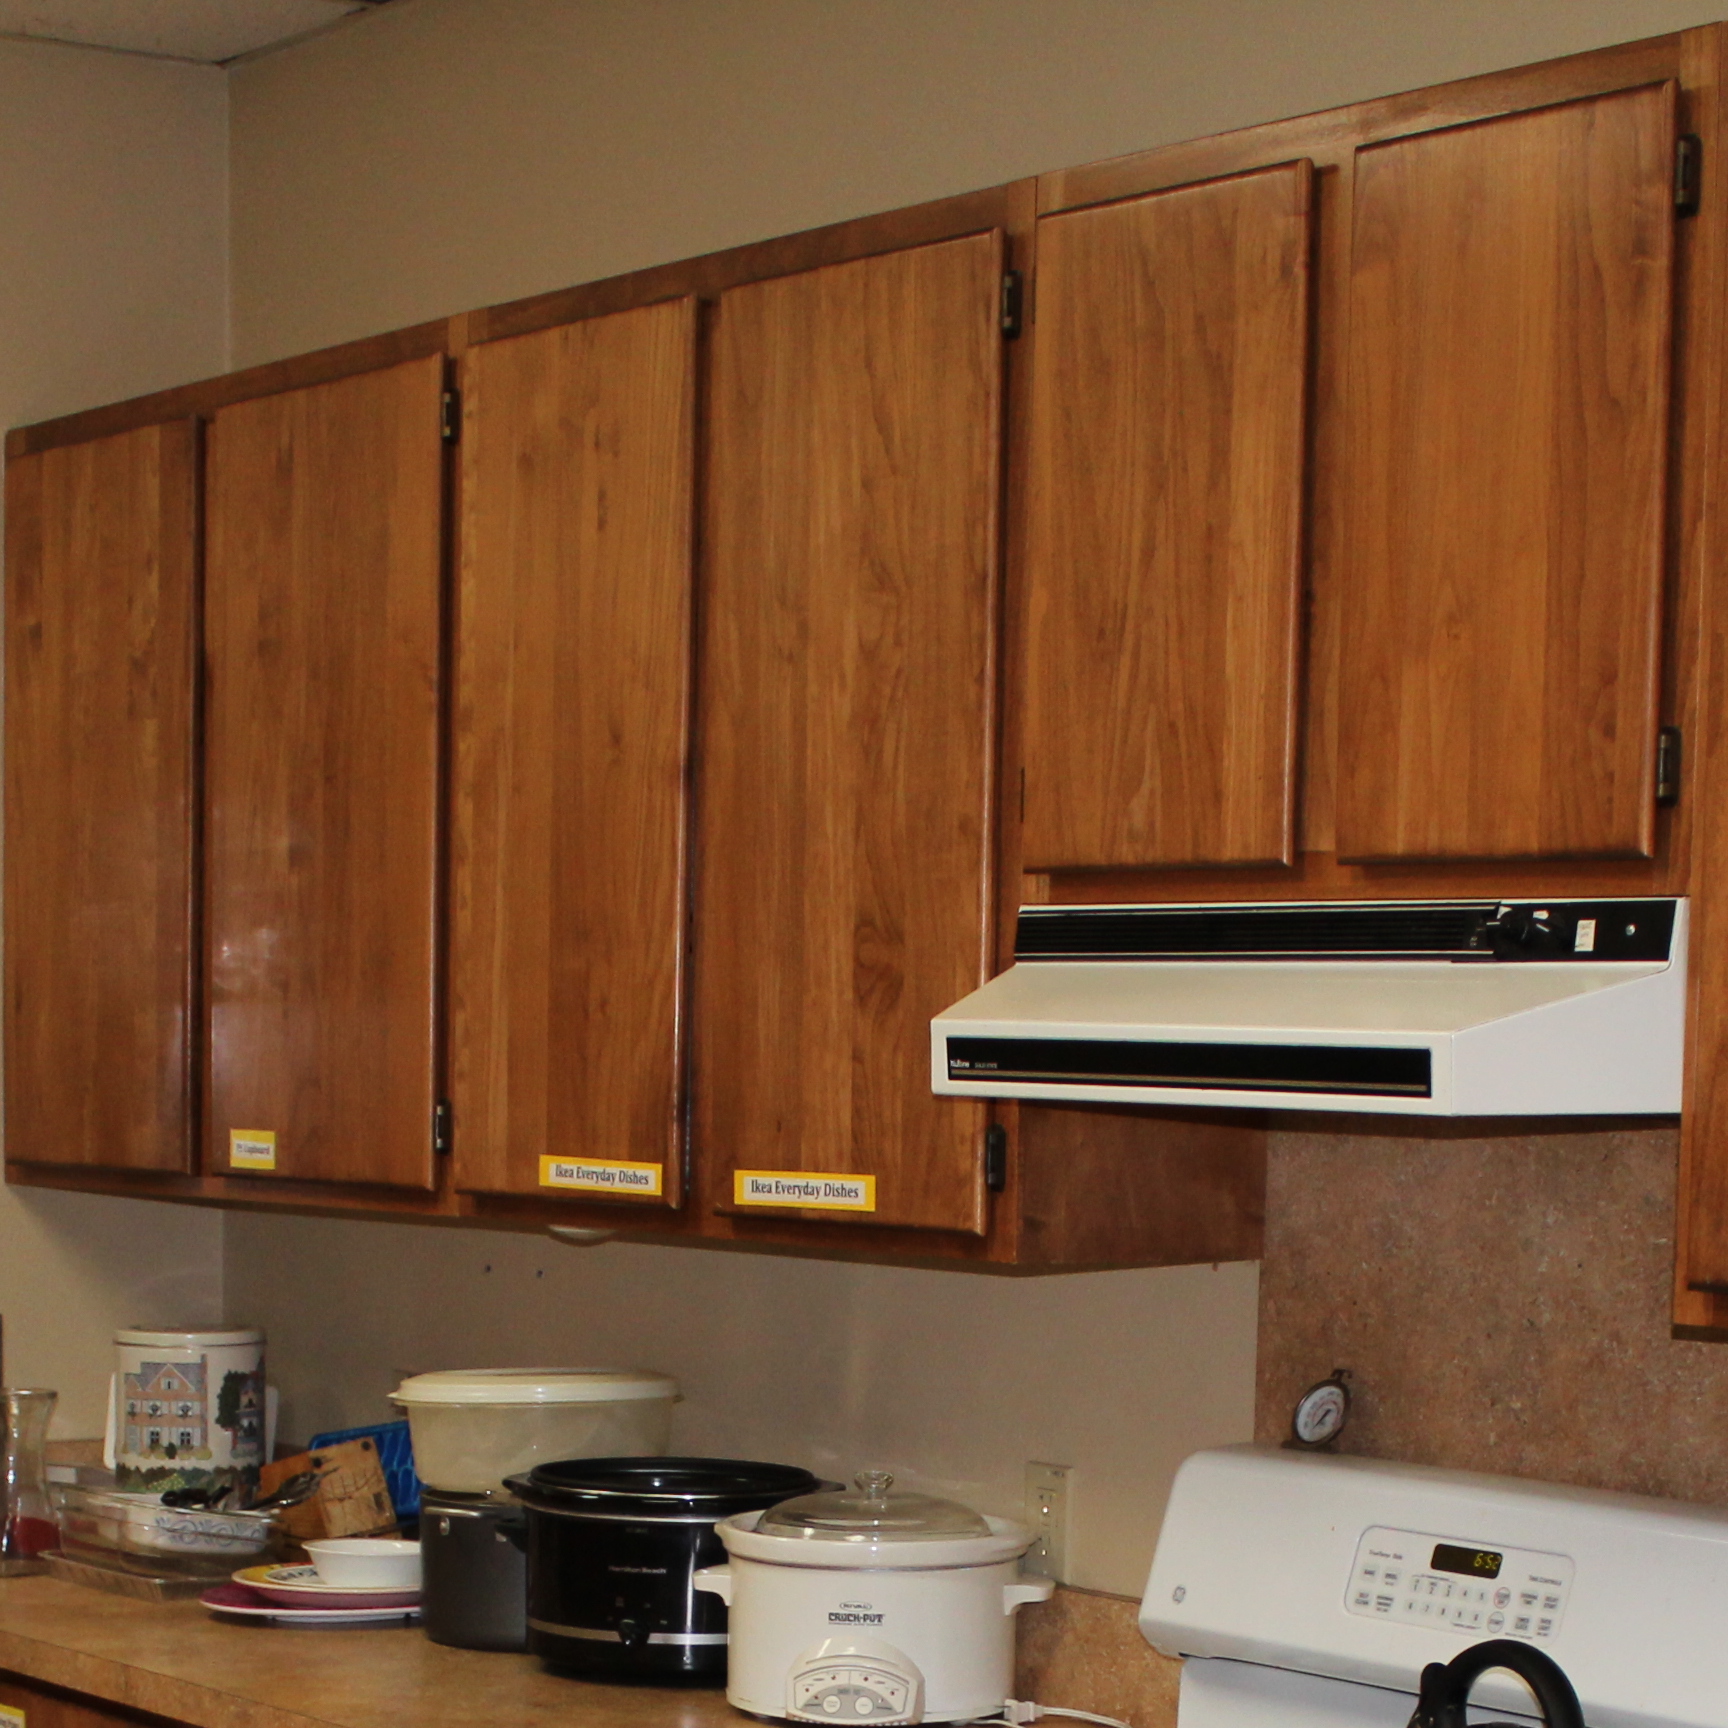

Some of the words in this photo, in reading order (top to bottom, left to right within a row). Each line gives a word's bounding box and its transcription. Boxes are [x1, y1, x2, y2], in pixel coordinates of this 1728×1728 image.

[555, 1164, 574, 1178] Ikea
[576, 1166, 617, 1186] Everyday
[619, 1170, 649, 1185] Dishes
[751, 1179, 772, 1194] Ikea
[775, 1181, 822, 1200] Everyday
[824, 1183, 859, 1198] Dishes
[642, 1566, 667, 1575] Beach
